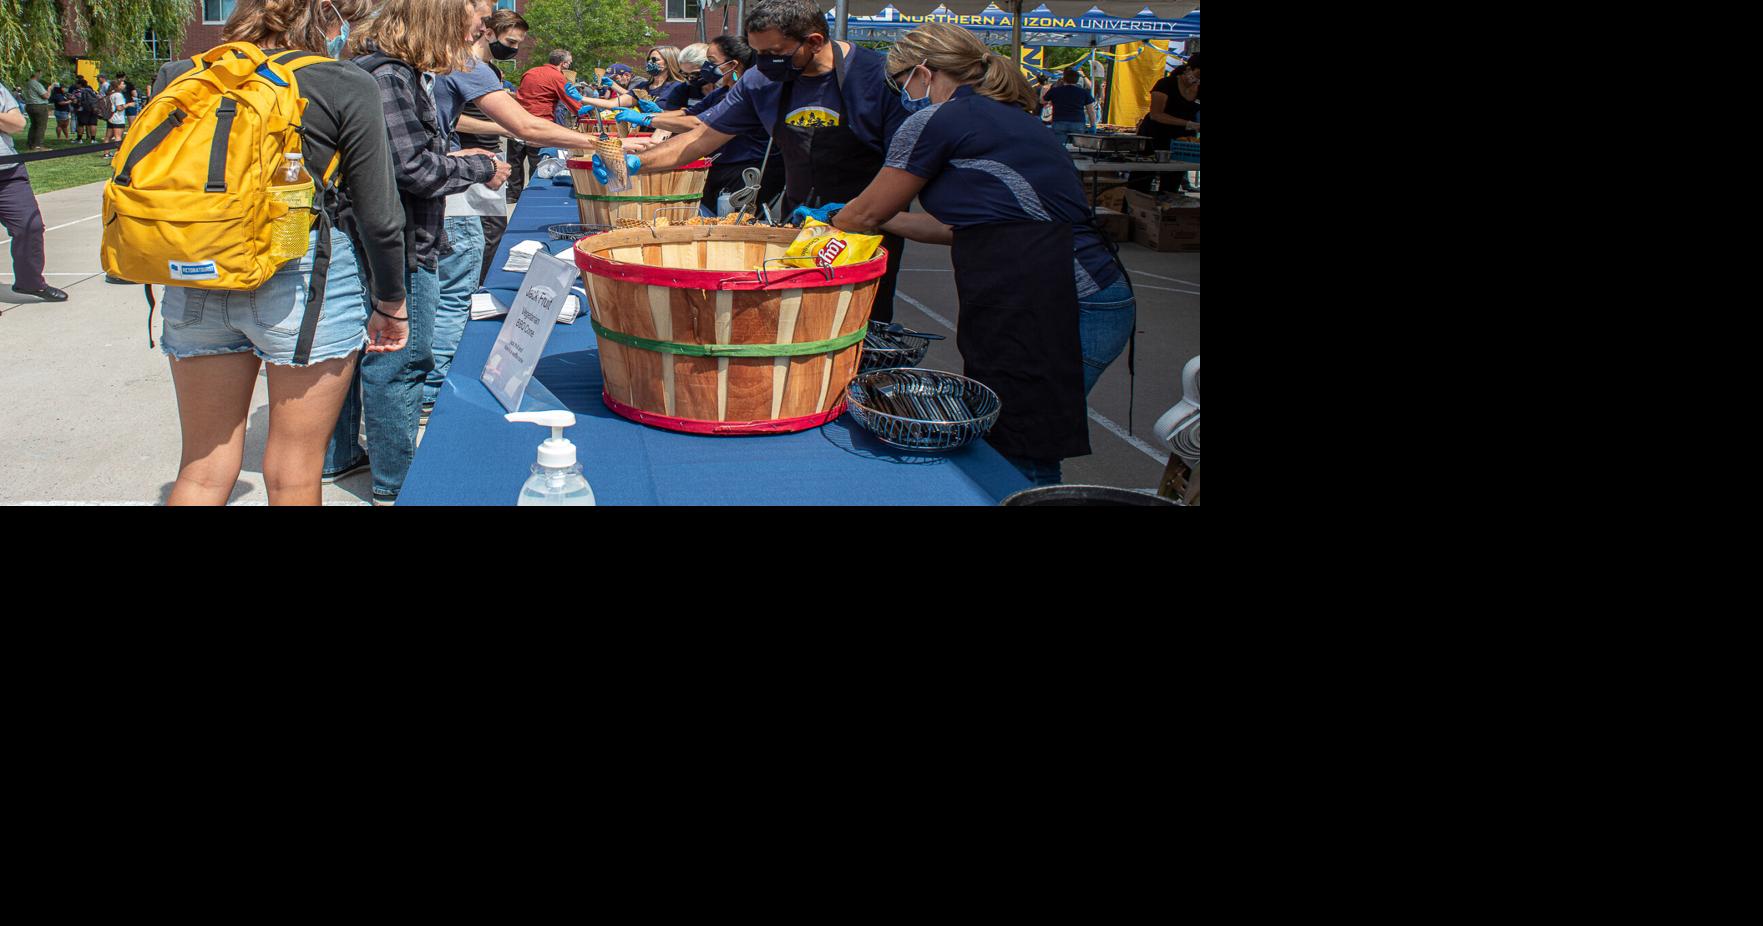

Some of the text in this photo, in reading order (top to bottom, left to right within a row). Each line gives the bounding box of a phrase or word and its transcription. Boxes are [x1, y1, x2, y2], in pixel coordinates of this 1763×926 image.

[900, 13, 995, 26] NORTHERN
[1000, 16, 1077, 28] AIZONA
[1080, 18, 1178, 31] UNIVERSITY
